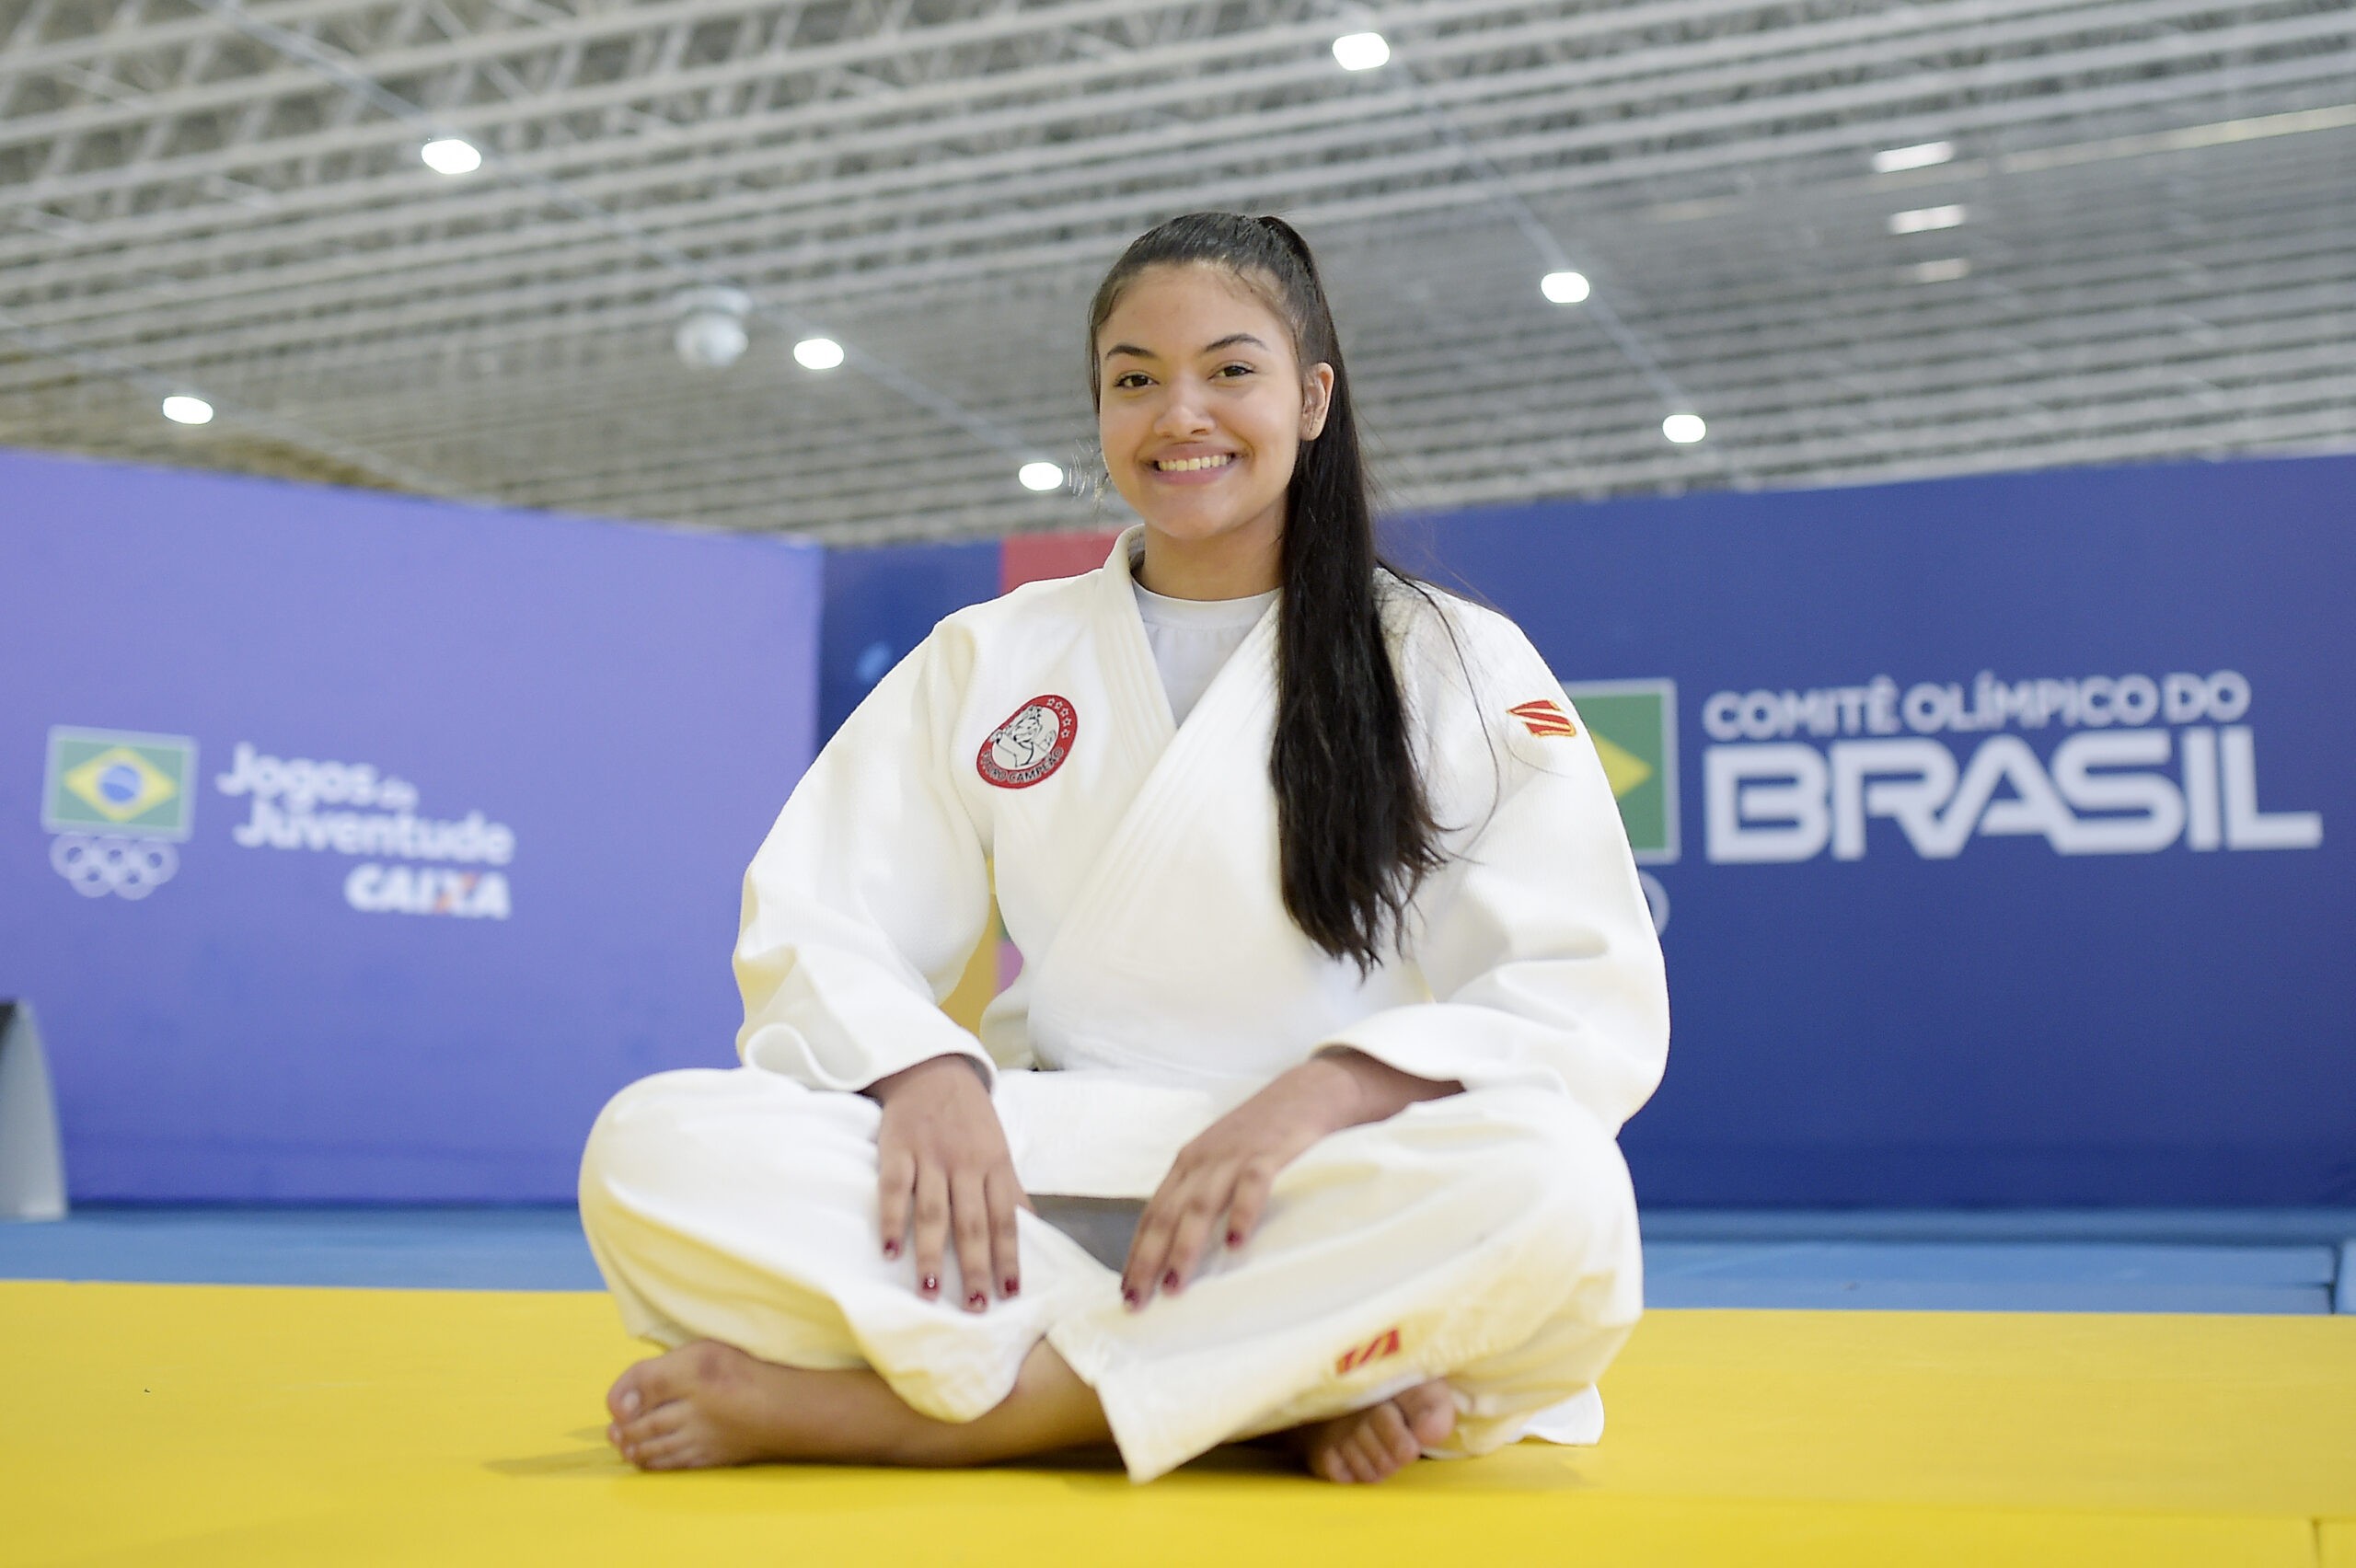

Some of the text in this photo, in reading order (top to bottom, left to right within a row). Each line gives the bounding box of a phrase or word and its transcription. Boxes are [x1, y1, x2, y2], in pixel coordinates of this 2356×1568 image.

[1704, 670, 2251, 739] COMITÊ OLÍMPICO DO
[216, 742, 377, 813] Jogos
[1703, 723, 2324, 865] BRASIL
[234, 797, 514, 865] Juventude
[344, 862, 511, 919] CAIXA
